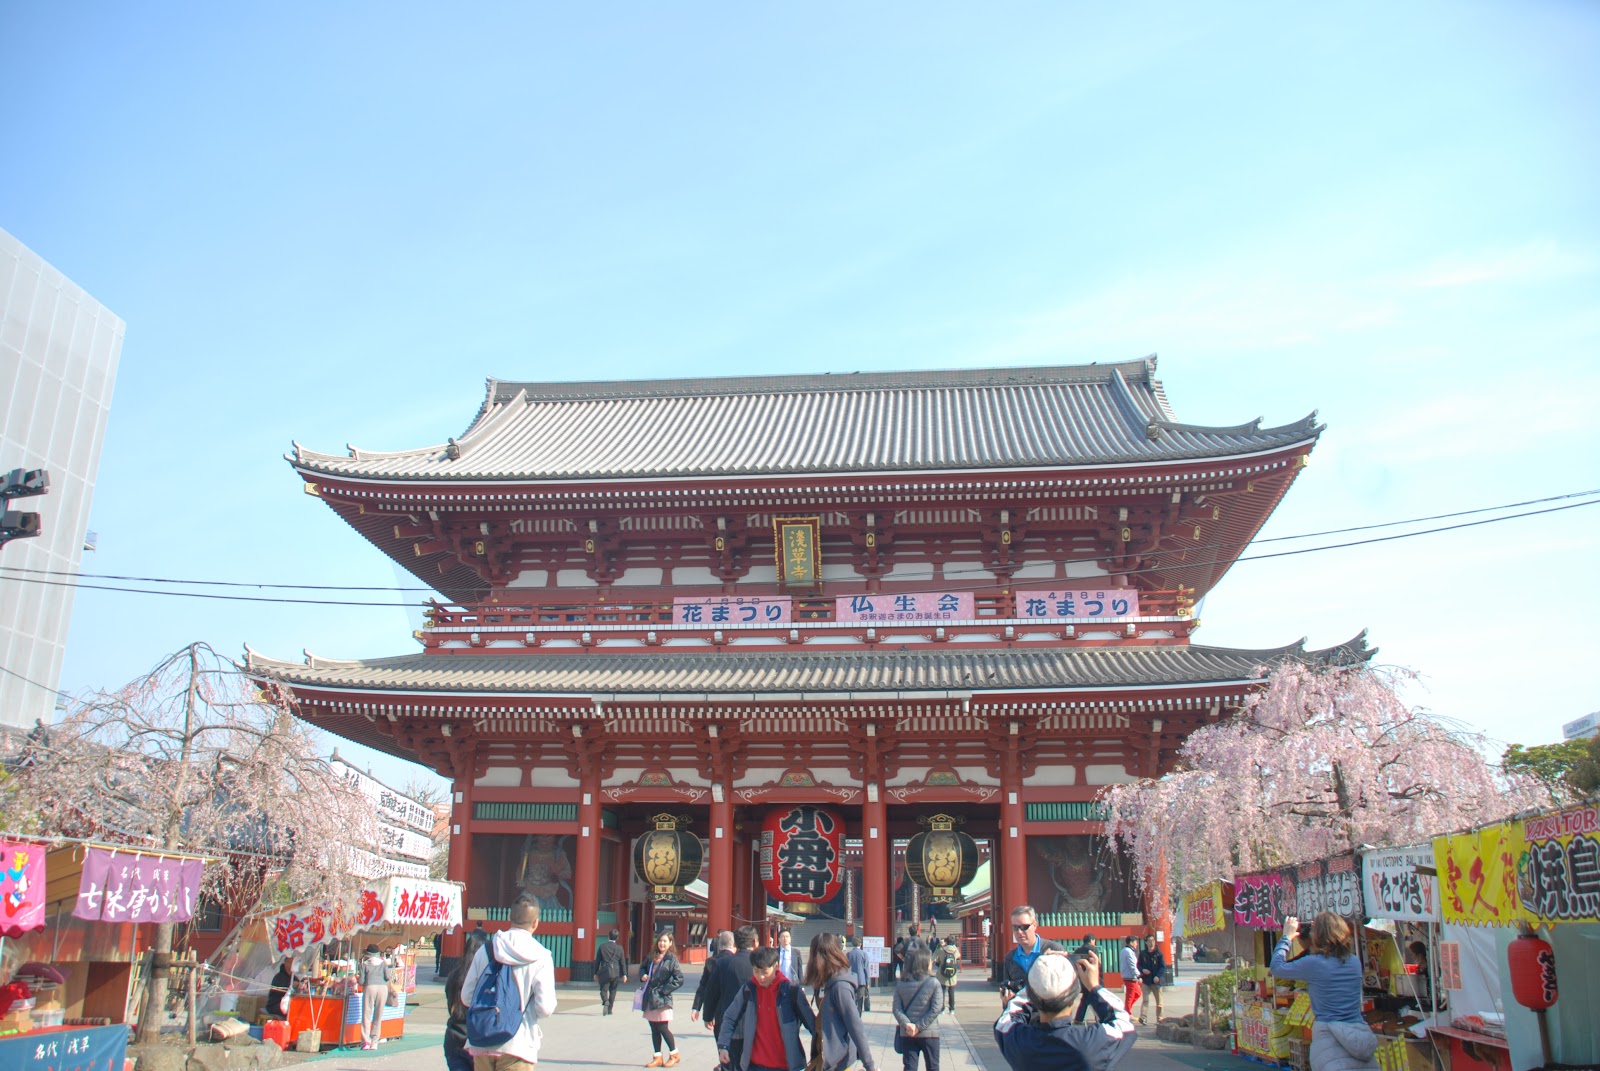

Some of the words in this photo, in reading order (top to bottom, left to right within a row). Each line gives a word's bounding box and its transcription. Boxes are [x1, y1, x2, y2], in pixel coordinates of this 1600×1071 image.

[850, 594, 960, 613] 仏生会
[1025, 598, 1129, 617] 花まつり
[1048, 591, 1105, 600] 4月8日
[682, 604, 782, 623] 花まつり
[1524, 807, 1600, 842] YAKITOR
[80, 882, 192, 919] 七味唐がらし
[398, 887, 450, 921] あんず屋さん
[1379, 871, 1423, 915] たこやき
